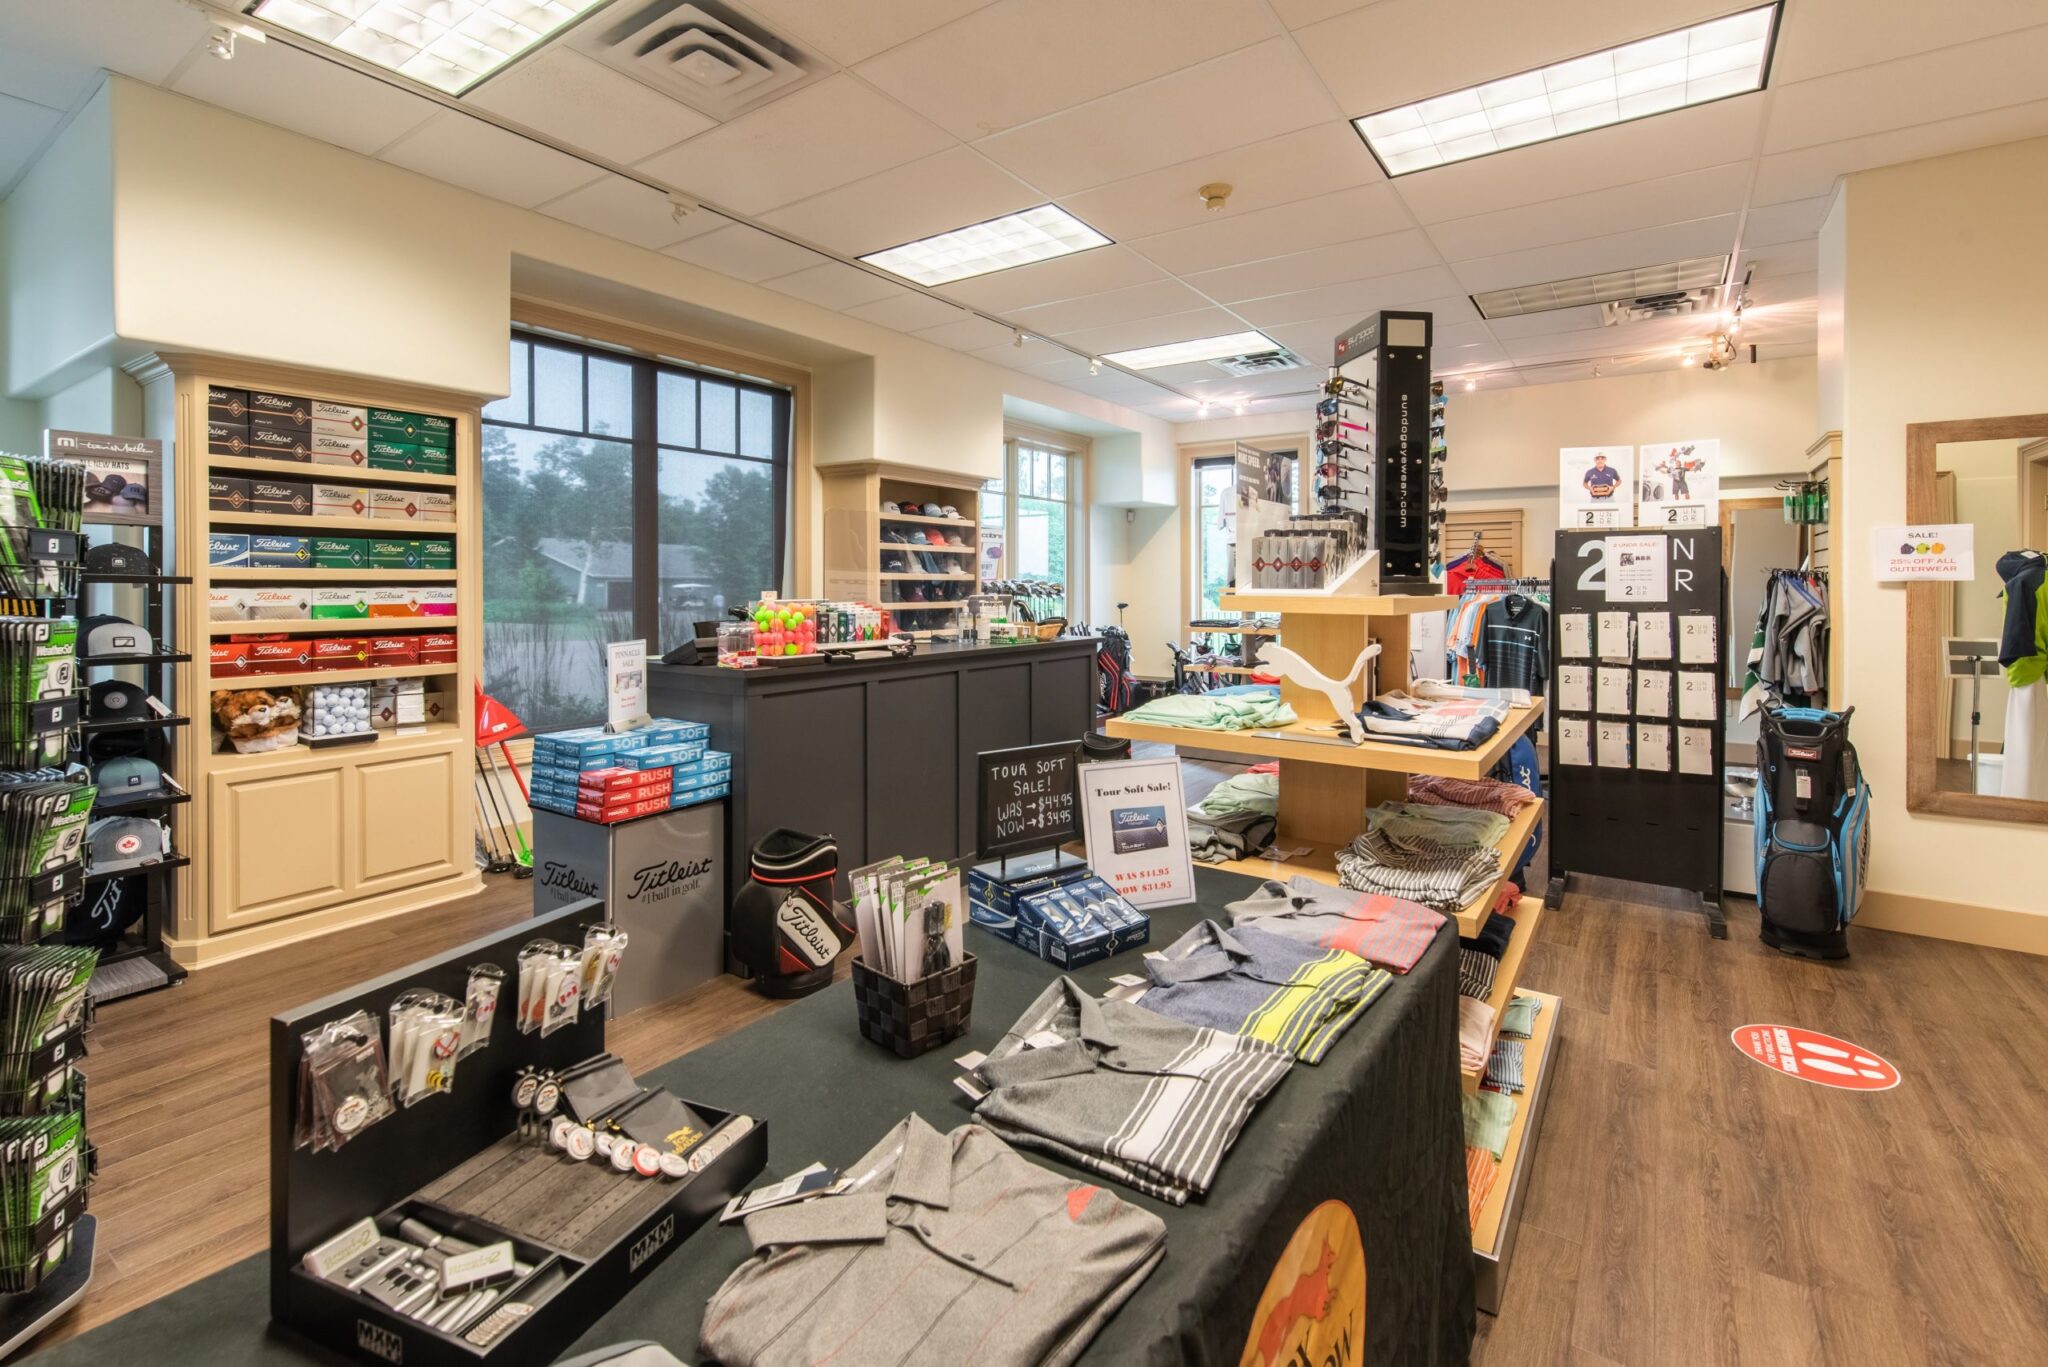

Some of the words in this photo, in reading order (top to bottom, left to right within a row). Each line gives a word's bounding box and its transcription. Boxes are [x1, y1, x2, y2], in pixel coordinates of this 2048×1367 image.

[254, 395, 293, 408] Titleist
[316, 404, 350, 415] Titleist
[372, 411, 404, 422] Titleist
[254, 431, 293, 443] Titleist
[316, 438, 350, 449] Titleist
[372, 444, 404, 455] Titleist
[94, 460, 109, 469] NEW
[112, 462, 130, 470] HATS
[254, 485, 293, 495] Titleist
[319, 489, 352, 499] Titleist
[374, 493, 405, 503] Titleist
[1585, 511, 1594, 524] 2
[1668, 509, 1677, 522] 2
[254, 538, 292, 548] Titleist
[315, 541, 350, 551] Titleist
[373, 543, 405, 552] Titleist
[1577, 540, 1606, 591] 2
[1673, 538, 1694, 561] N
[1675, 569, 1694, 592] R
[317, 592, 351, 600] Titleist
[373, 592, 405, 600] Titleist
[424, 592, 453, 600] Titleist
[1625, 585, 1633, 596] 2
[254, 592, 293, 602] Titleist
[1565, 622, 1572, 632] 2
[1603, 620, 1611, 629] 2
[1644, 621, 1652, 630] 2
[1687, 625, 1695, 635] 2
[35, 624, 49, 641] FJ
[317, 643, 352, 653] Titleist
[373, 640, 405, 650] Titleist
[424, 638, 455, 647] Titleist
[254, 646, 293, 656] Titleist
[1564, 675, 1571, 684] 2
[1602, 677, 1609, 686] 2
[1643, 679, 1651, 688] 2
[1686, 681, 1693, 691] 2
[52, 706, 62, 723] FJ
[680, 726, 708, 739] SOFT
[1564, 729, 1571, 738] 2
[1602, 731, 1609, 740] 2
[1643, 732, 1650, 742] 2
[612, 736, 648, 749] SOFT
[1684, 736, 1691, 746] 2
[671, 748, 702, 761] SOFT
[703, 756, 731, 770] SOFT
[991, 763, 1027, 781] TOUR
[1036, 757, 1066, 774] SOFT
[640, 770, 672, 783] RUSH
[702, 769, 730, 784] SOFT
[639, 783, 671, 798] RUSH
[700, 784, 728, 797] SOFT
[1013, 775, 1051, 796] SALE!
[1095, 787, 1121, 797] Tour
[1124, 785, 1144, 795] Soft
[1147, 782, 1171, 792] Sale!
[54, 793, 70, 813] FJ
[637, 797, 669, 813] RUSH
[997, 800, 1022, 821] WAS
[1038, 793, 1073, 811] $44.95
[1118, 811, 1151, 824] Titleist
[997, 817, 1025, 838] NOW
[540, 860, 599, 898] Titleist
[627, 857, 713, 900] Titleist
[1115, 871, 1137, 881] WAS
[52, 874, 63, 892] FJ
[1142, 881, 1172, 892] $34.95
[641, 892, 650, 904] #1
[651, 887, 670, 903] ball
[671, 883, 681, 897] in
[781, 906, 830, 959] Titleist
[54, 1042, 65, 1062] FJ
[33, 1133, 48, 1158] FJ
[54, 1209, 65, 1230] FJ
[632, 1217, 672, 1261] MXM
[359, 1321, 401, 1352] MXM
